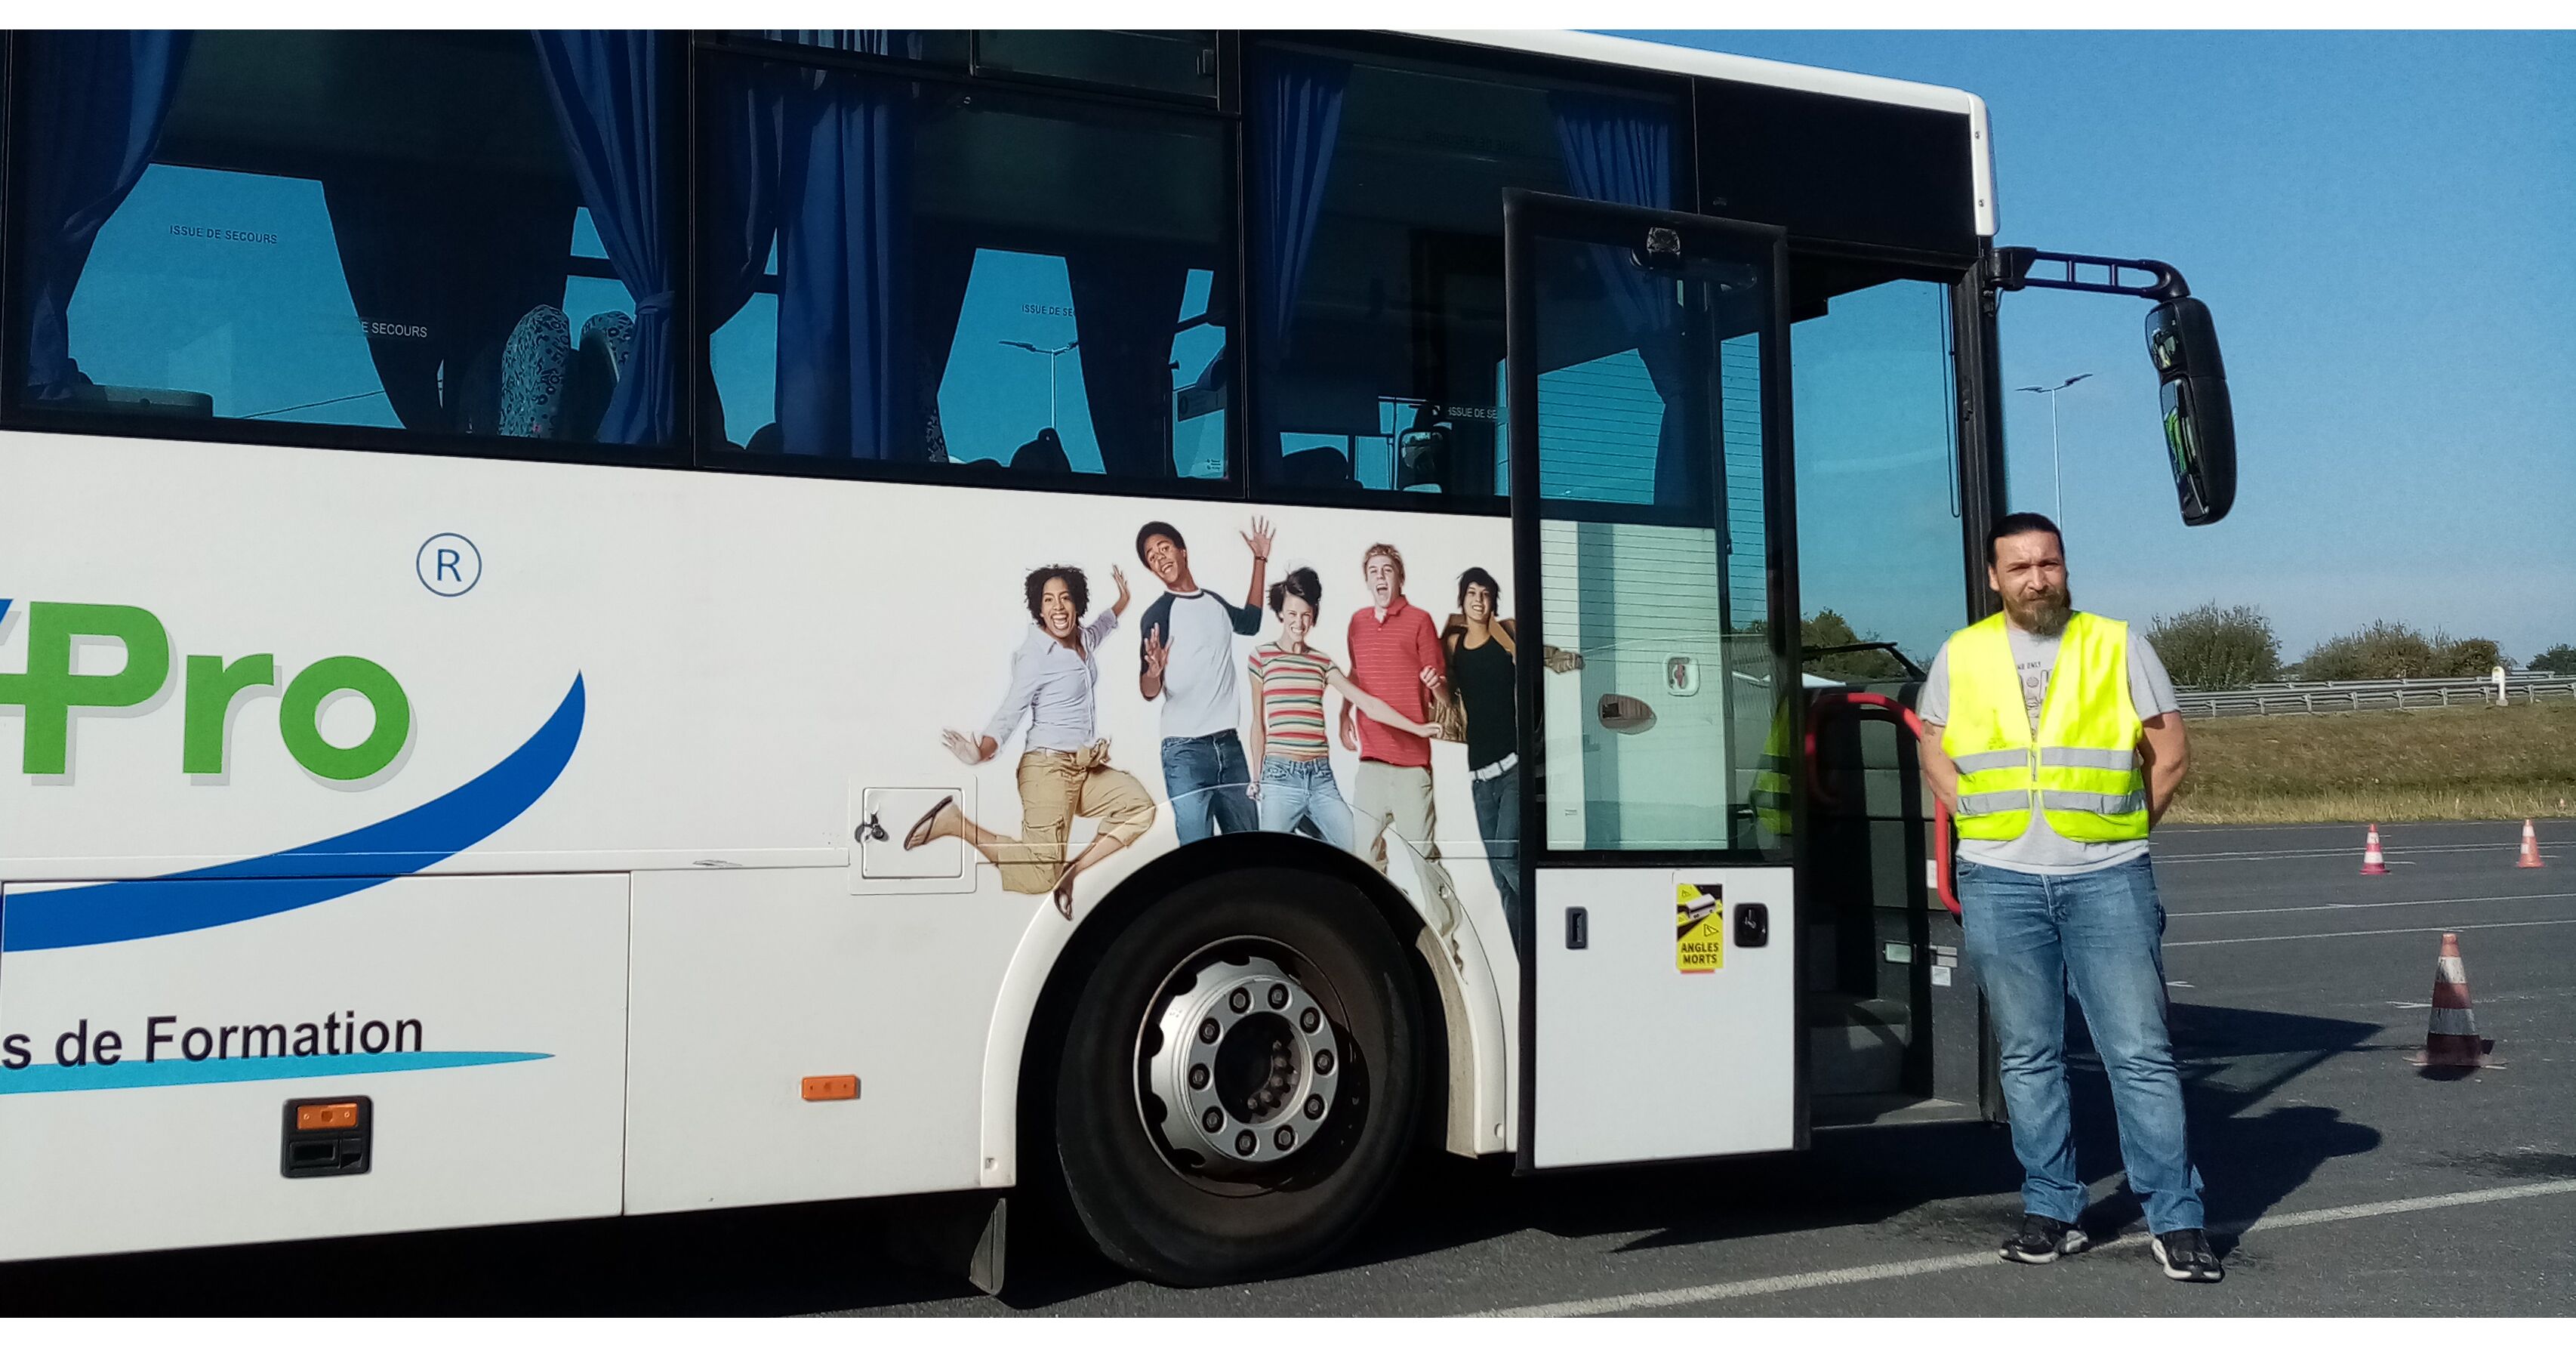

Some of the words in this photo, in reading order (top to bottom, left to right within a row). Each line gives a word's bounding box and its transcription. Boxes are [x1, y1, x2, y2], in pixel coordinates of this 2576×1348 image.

[170, 225, 203, 237] ISSUE
[207, 228, 221, 239] DE
[225, 230, 277, 244] SECOURS
[1021, 304, 1047, 315] ISSUE
[1049, 306, 1060, 316] DE
[1062, 307, 1075, 316] SE
[371, 322, 427, 338] SECOURS
[1449, 407, 1473, 418] ISSUE
[1474, 409, 1485, 418] DE
[0, 598, 410, 780] Pro
[1681, 942, 1719, 952] ANGLES
[1683, 954, 1718, 964] MORTS
[55, 1019, 123, 1068] de
[145, 1010, 423, 1064] Formation
